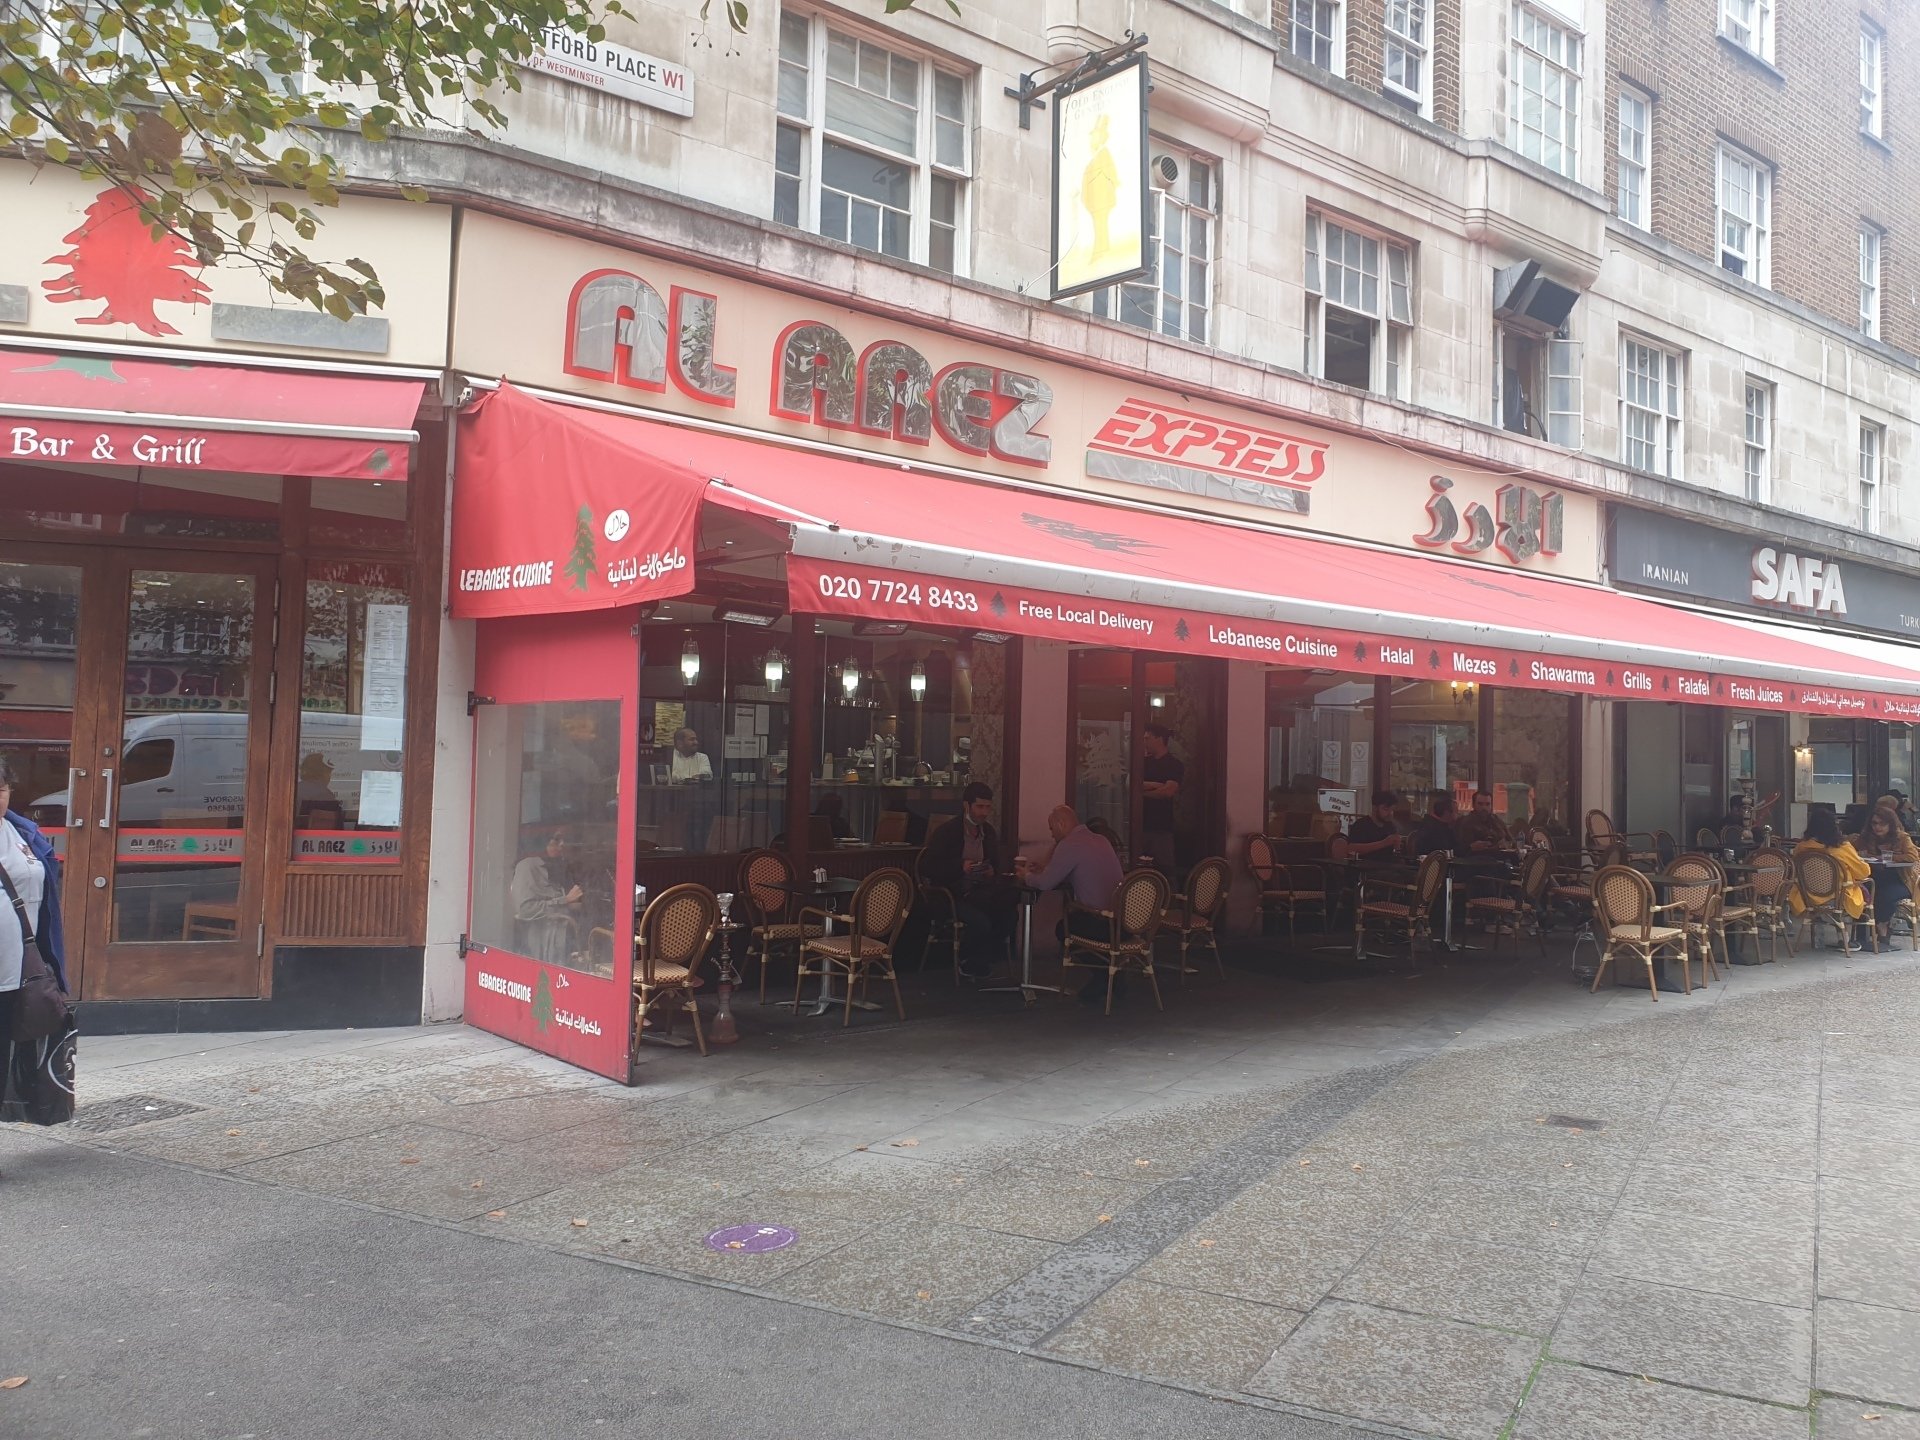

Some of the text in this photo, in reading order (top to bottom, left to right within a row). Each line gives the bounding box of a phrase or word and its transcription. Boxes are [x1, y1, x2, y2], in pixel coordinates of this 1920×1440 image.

[533, 56, 544, 67] OF
[546, 60, 605, 86] WESTMINSTER
[606, 50, 657, 82] PLACE
[662, 68, 684, 91] W1
[563, 268, 738, 409] AL
[10, 427, 207, 465] Bar & Grill
[1093, 404, 1326, 483] EXPRESS
[460, 561, 554, 592] LEBANESE CUISINE
[1642, 563, 1689, 586] IRANIAN
[1752, 547, 1848, 614] SAFA
[819, 574, 979, 612] 020 7724 8433
[1019, 600, 1154, 634] Free Local Delivery
[1900, 614, 1920, 629] TURK
[1209, 624, 1338, 658] Lebanese Cuisine
[1380, 645, 1414, 665] Halal
[1453, 652, 1497, 675] Mezes
[1531, 661, 1595, 686] Shawarma
[1623, 670, 1652, 690] Grills
[1678, 676, 1710, 696] Falafel
[1731, 682, 1783, 703] Fresh Juices
[302, 840, 315, 853] AL
[478, 971, 532, 1003] LEBANESE CUISINE
